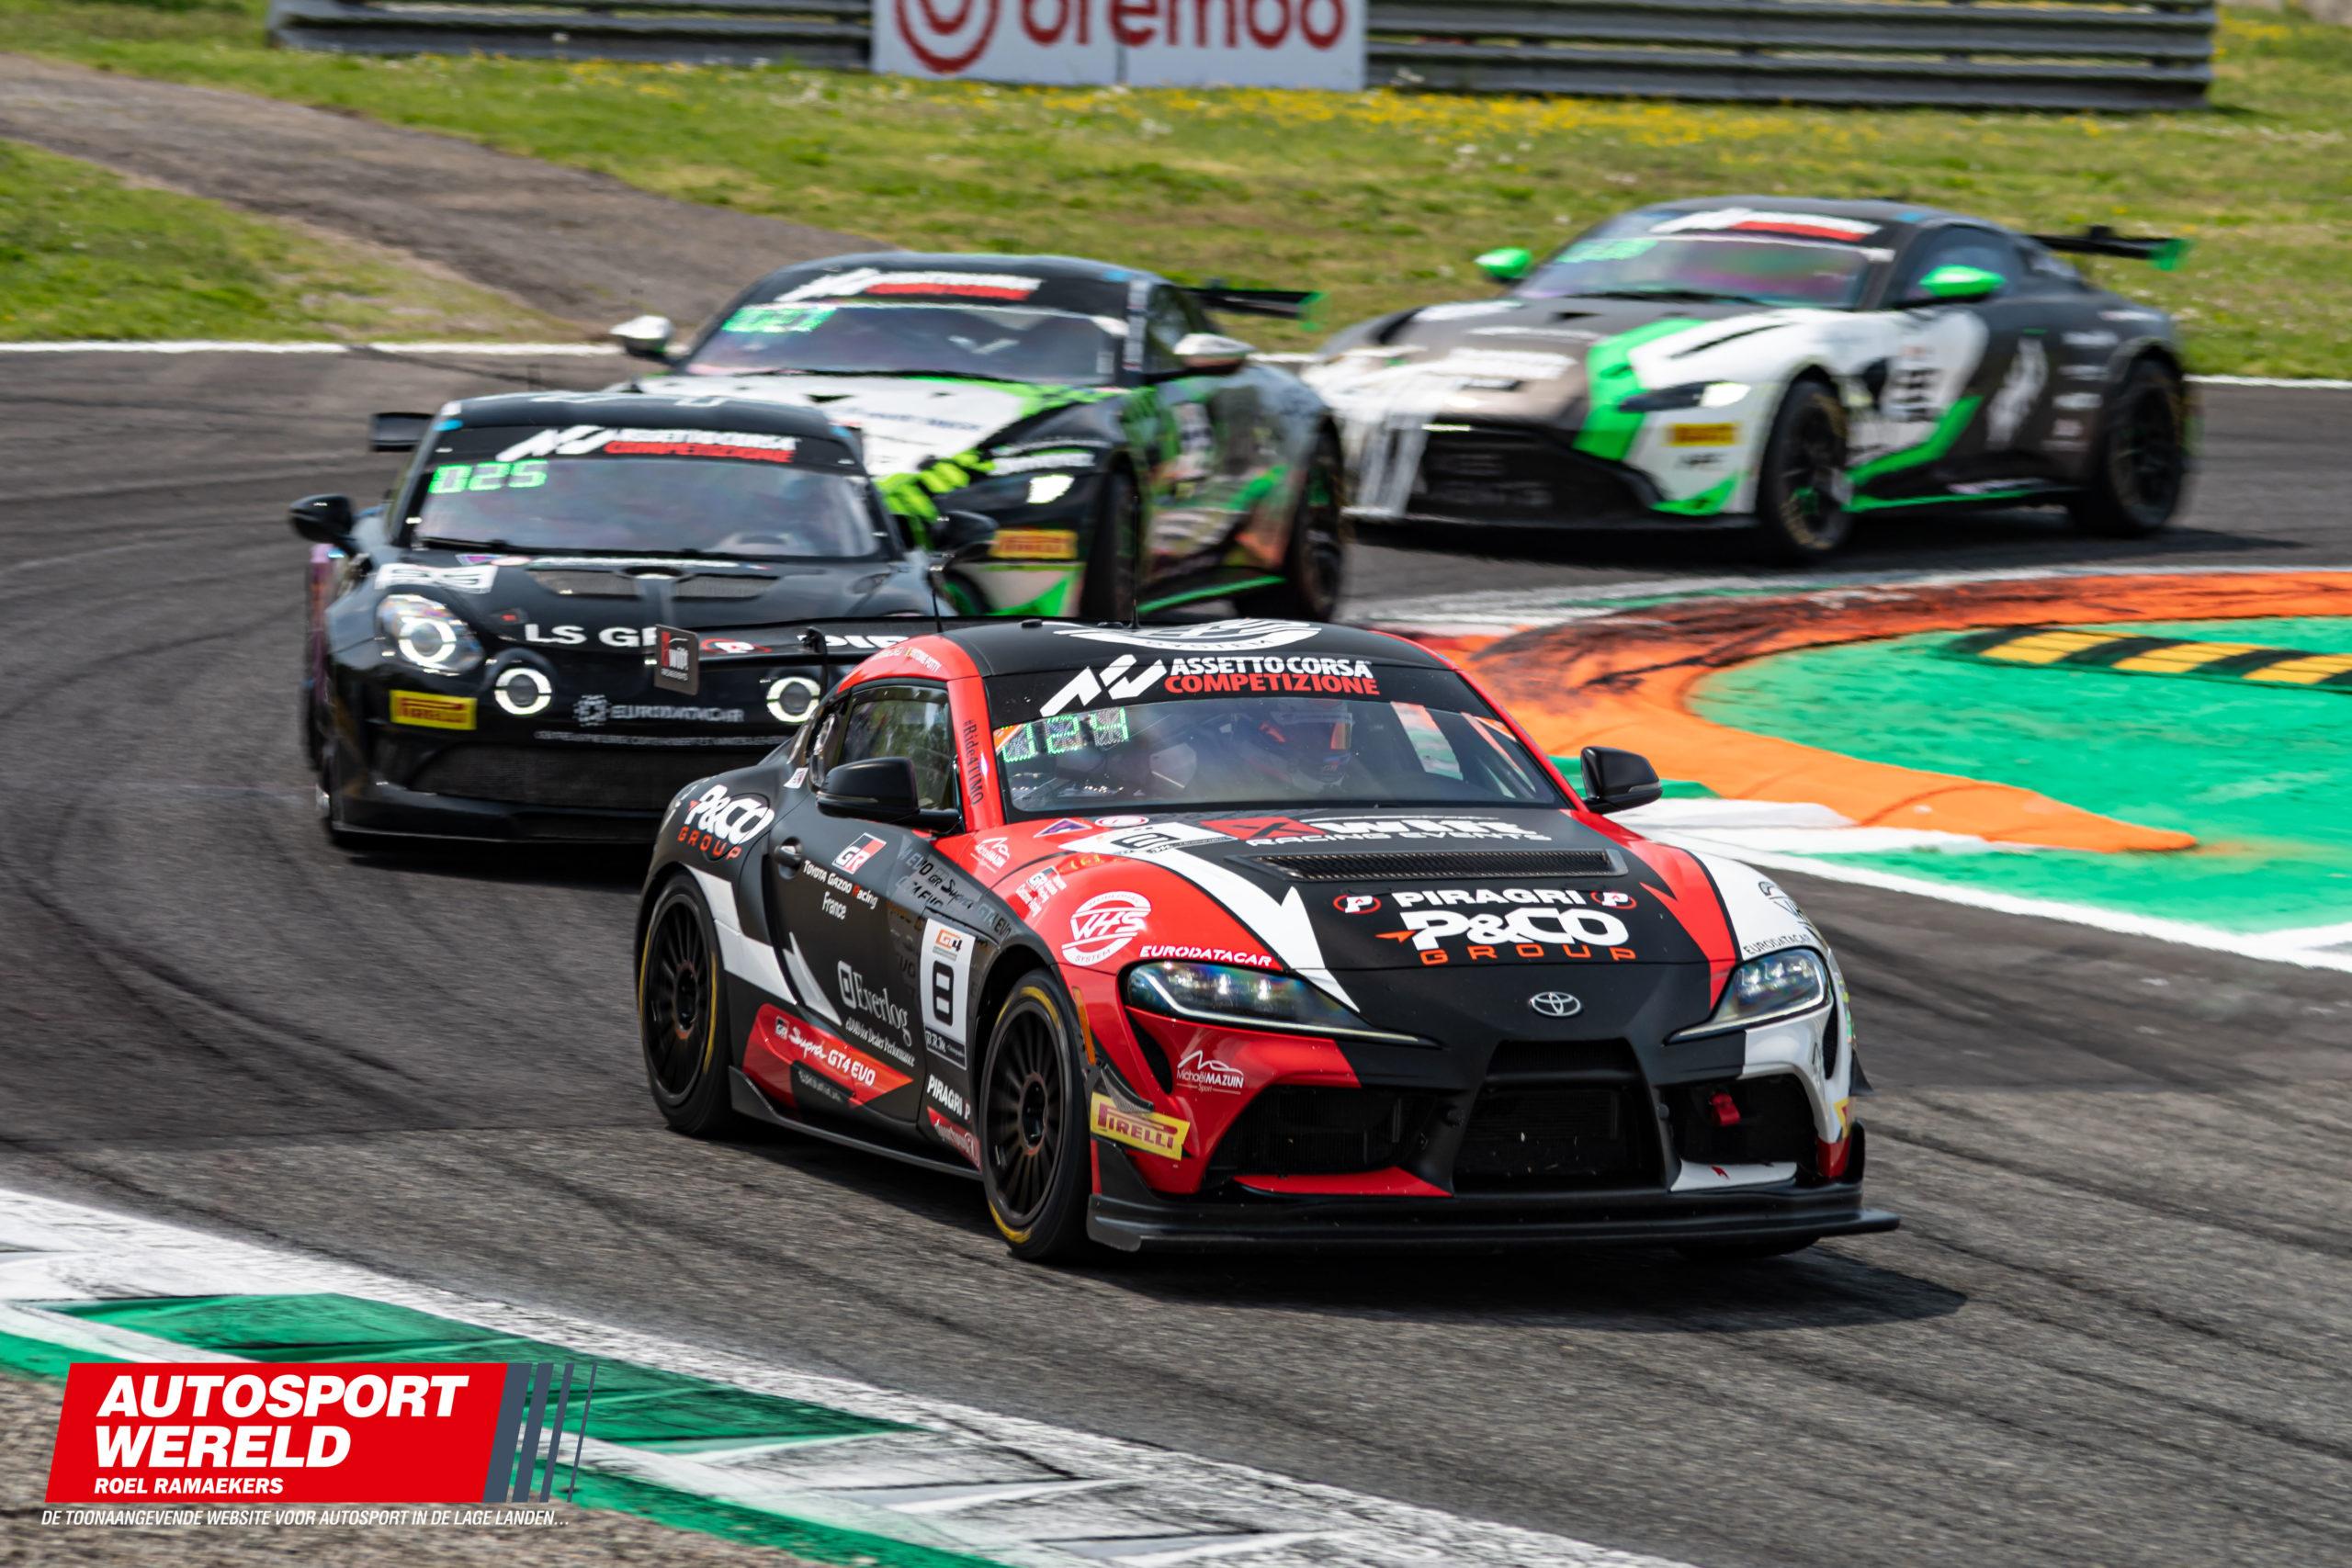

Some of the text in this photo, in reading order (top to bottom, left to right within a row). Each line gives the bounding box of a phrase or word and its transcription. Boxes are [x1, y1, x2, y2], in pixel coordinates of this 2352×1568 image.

[428, 459, 548, 494] 025
[525, 624, 588, 644] LS
[1164, 673, 1380, 695] COMPETIZIONE
[1170, 656, 1374, 679] ASSETTO CORSA
[684, 784, 775, 845] P&CO
[677, 825, 743, 861] GROUP
[834, 845, 874, 874] GR
[803, 859, 879, 910] TOYOTA GAZOO Racing
[1391, 888, 1588, 908] PIRAGRI
[822, 890, 847, 919] France
[1399, 907, 1630, 952] P&CO
[1139, 944, 1272, 967] EURODATACAR
[1419, 942, 1636, 965] GROUP
[853, 971, 912, 1047] Everlog
[933, 960, 955, 1027] 8
[788, 1026, 828, 1059] Supra
[827, 1049, 852, 1074] GT4
[851, 1063, 876, 1086] EVO
[926, 1073, 964, 1117] PIRAGRI
[1097, 1102, 1179, 1150] PIRELLI
